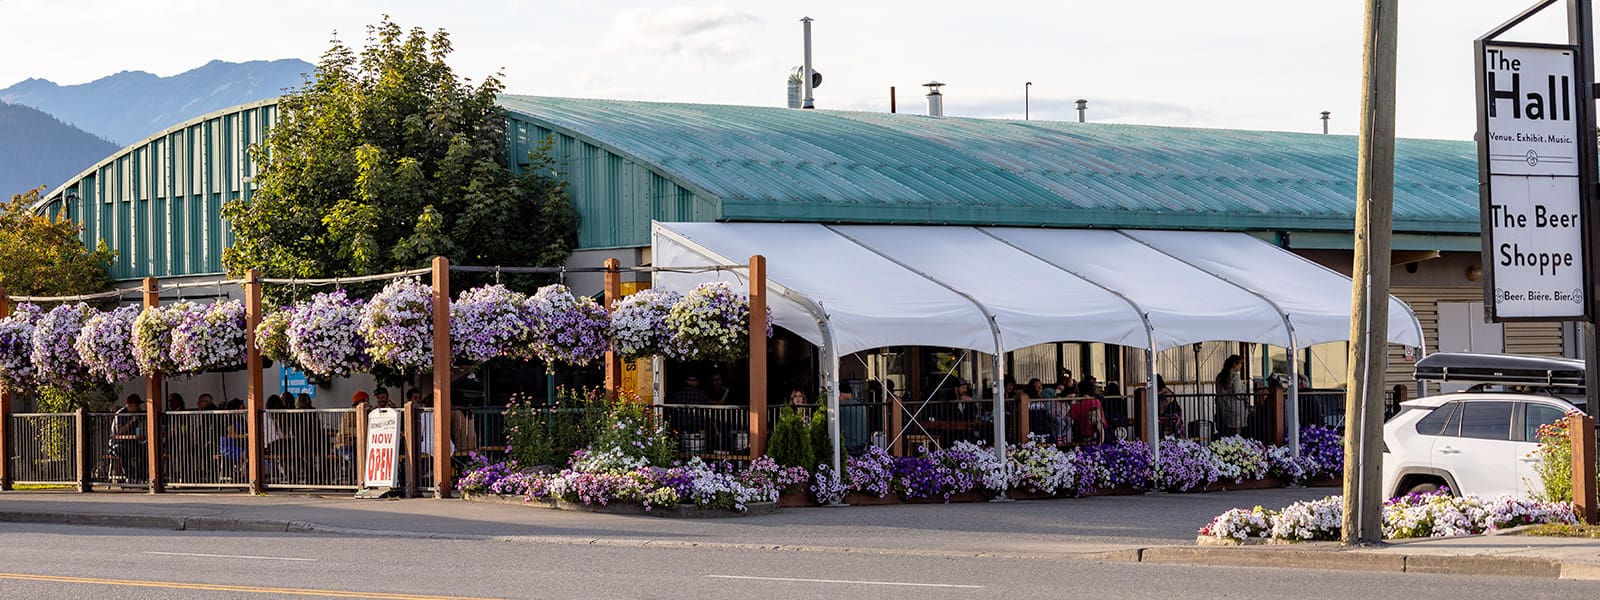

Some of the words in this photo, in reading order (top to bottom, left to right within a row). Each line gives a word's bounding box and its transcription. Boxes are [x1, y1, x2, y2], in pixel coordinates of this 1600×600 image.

[1487, 49, 1521, 71] The
[1488, 71, 1570, 121] Hall
[1489, 132, 1515, 142] Venue.
[1516, 133, 1547, 143] Exhibit.
[1547, 134, 1573, 144] Music.
[1491, 205, 1527, 228] The
[1535, 204, 1578, 228] Beer
[1500, 243, 1573, 276] Shoppe
[1504, 290, 1526, 301] Beer.
[1554, 290, 1573, 301] Bier.
[371, 433, 392, 444] NOW
[368, 447, 393, 481] OPEN
